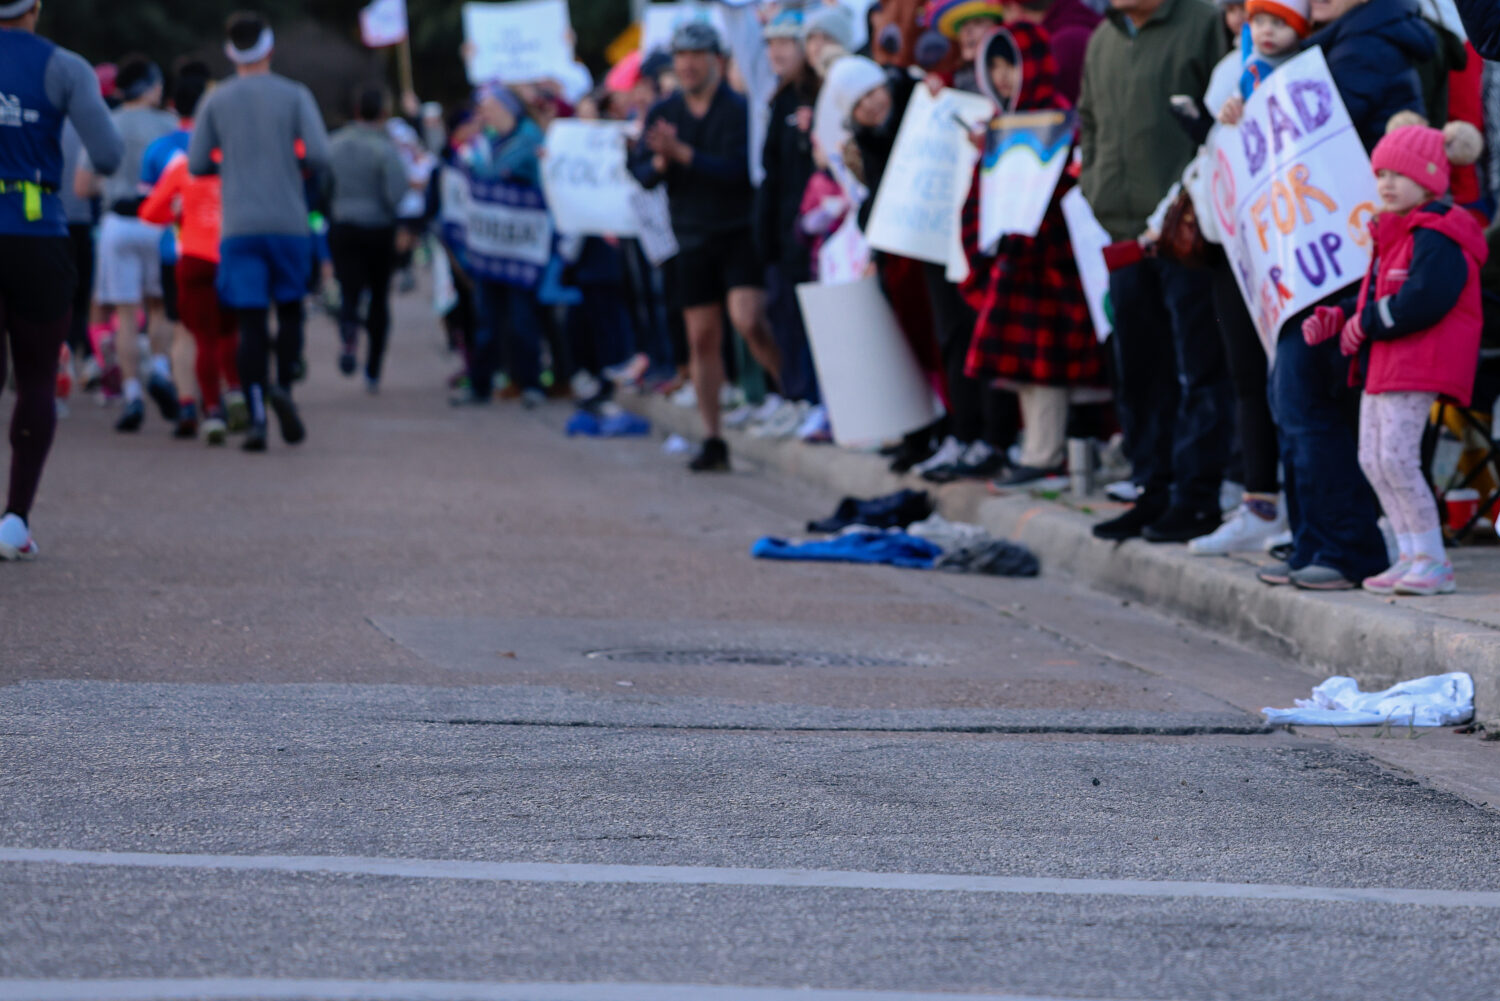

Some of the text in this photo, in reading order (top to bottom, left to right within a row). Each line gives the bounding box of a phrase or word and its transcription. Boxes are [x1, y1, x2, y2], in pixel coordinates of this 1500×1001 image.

[1240, 79, 1332, 177] DAD
[1250, 163, 1338, 253] FOR
[1295, 232, 1342, 287] UP
